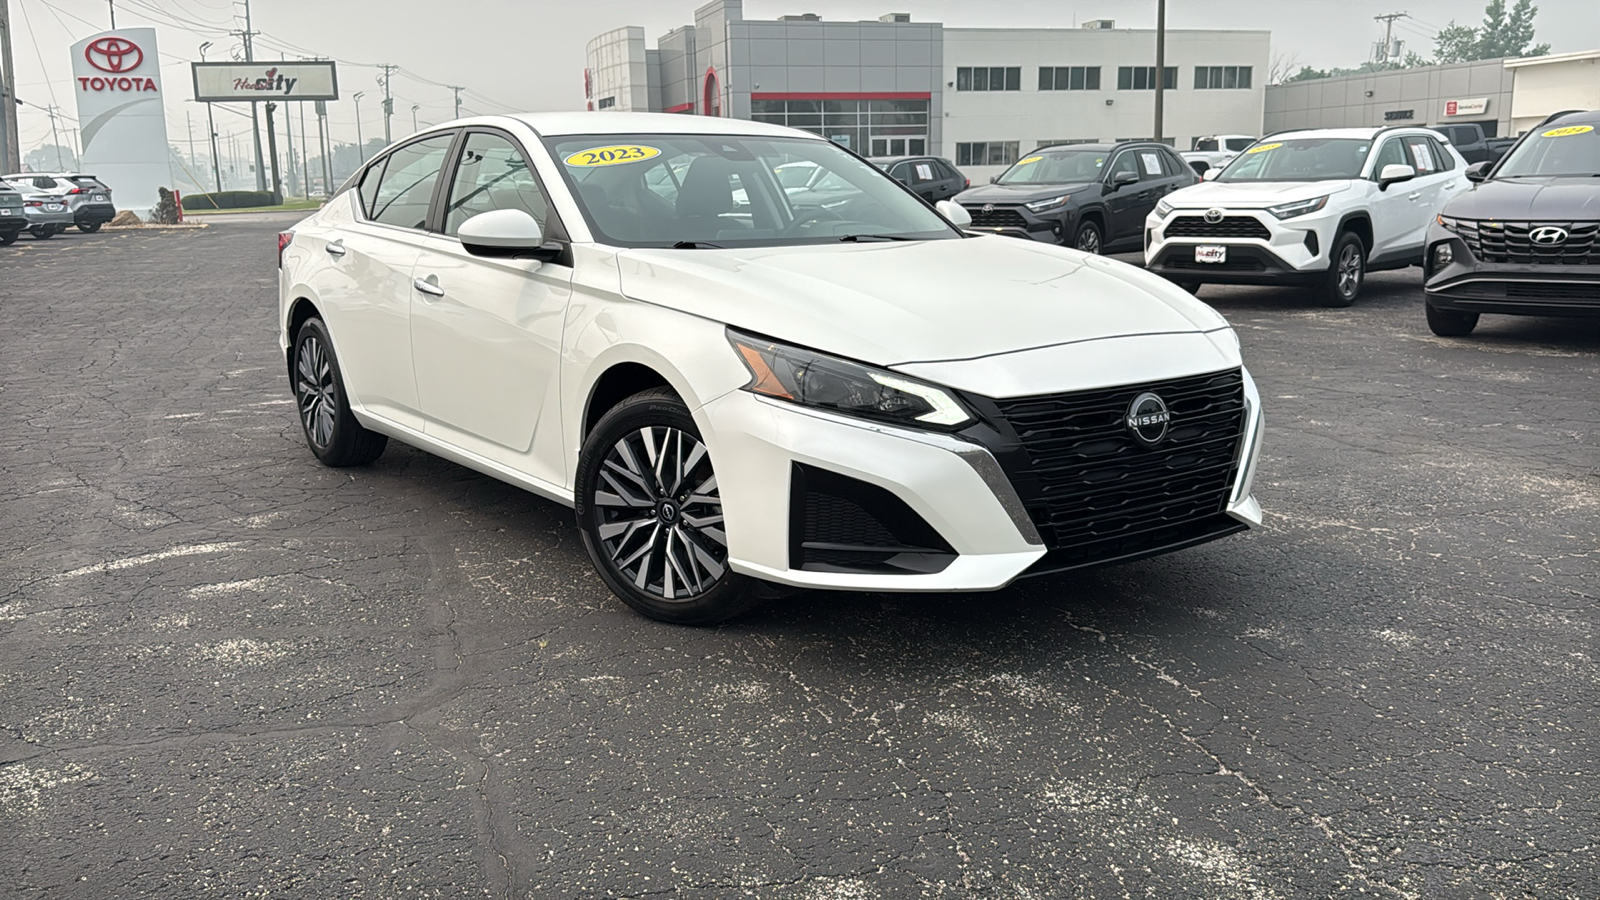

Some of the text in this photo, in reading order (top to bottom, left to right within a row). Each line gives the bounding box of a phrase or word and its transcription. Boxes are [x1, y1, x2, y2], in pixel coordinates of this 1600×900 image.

[77, 77, 158, 92] TOYOTA
[582, 147, 646, 165] 2023
[1128, 412, 1170, 427] NISSAN
